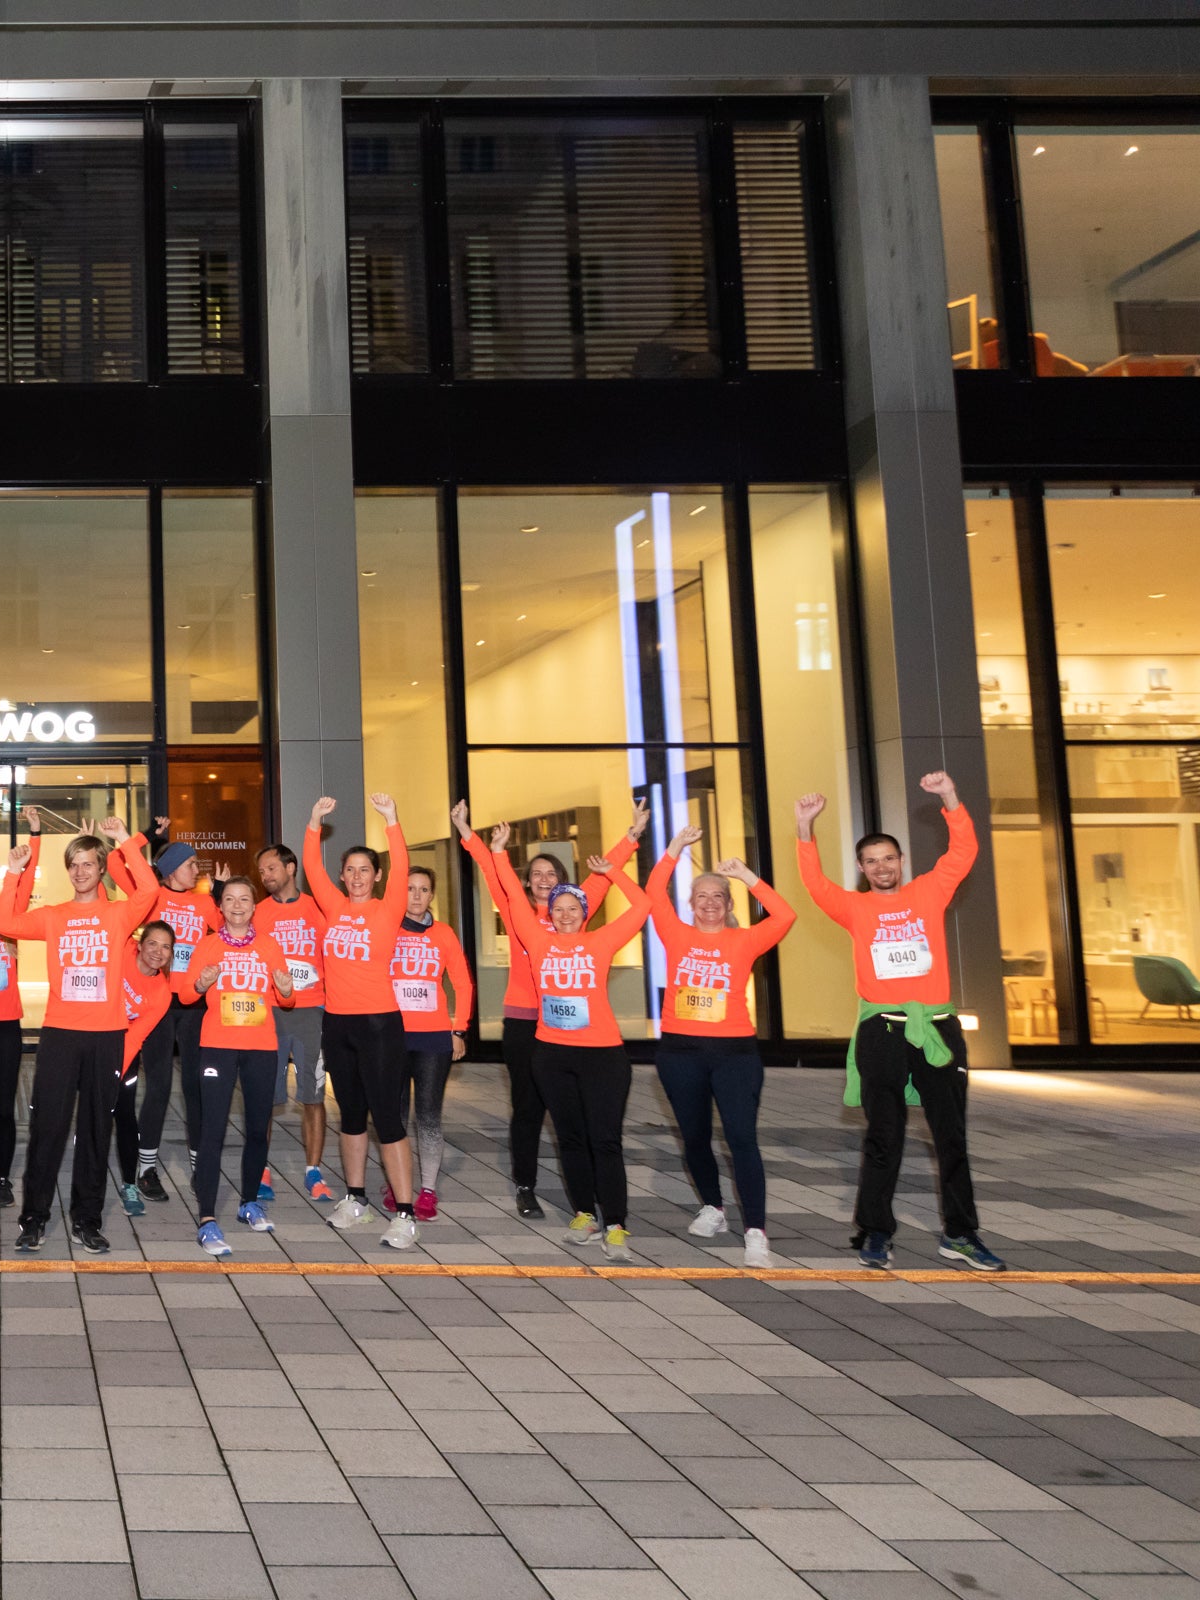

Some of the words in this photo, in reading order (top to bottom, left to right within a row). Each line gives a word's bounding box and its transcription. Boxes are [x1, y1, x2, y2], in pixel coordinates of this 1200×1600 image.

[176, 832, 226, 840] HERZLICH
[183, 841, 246, 850] LKOMMEN
[878, 911, 907, 921] ERSTE
[67, 918, 91, 927] ERSTE
[59, 930, 109, 952] night
[58, 945, 108, 967] run
[175, 950, 191, 960] 458
[323, 939, 370, 961] run
[888, 950, 917, 963] 4040
[218, 957, 268, 976] night
[389, 957, 440, 977] run
[541, 953, 596, 975] night
[290, 967, 309, 979] 4038
[540, 968, 597, 989] run
[71, 975, 98, 987] 10090
[216, 971, 269, 993] run
[402, 987, 428, 998] 10084
[232, 1001, 256, 1012] 19138
[686, 995, 713, 1007] 19139
[550, 1004, 576, 1016] 14582
